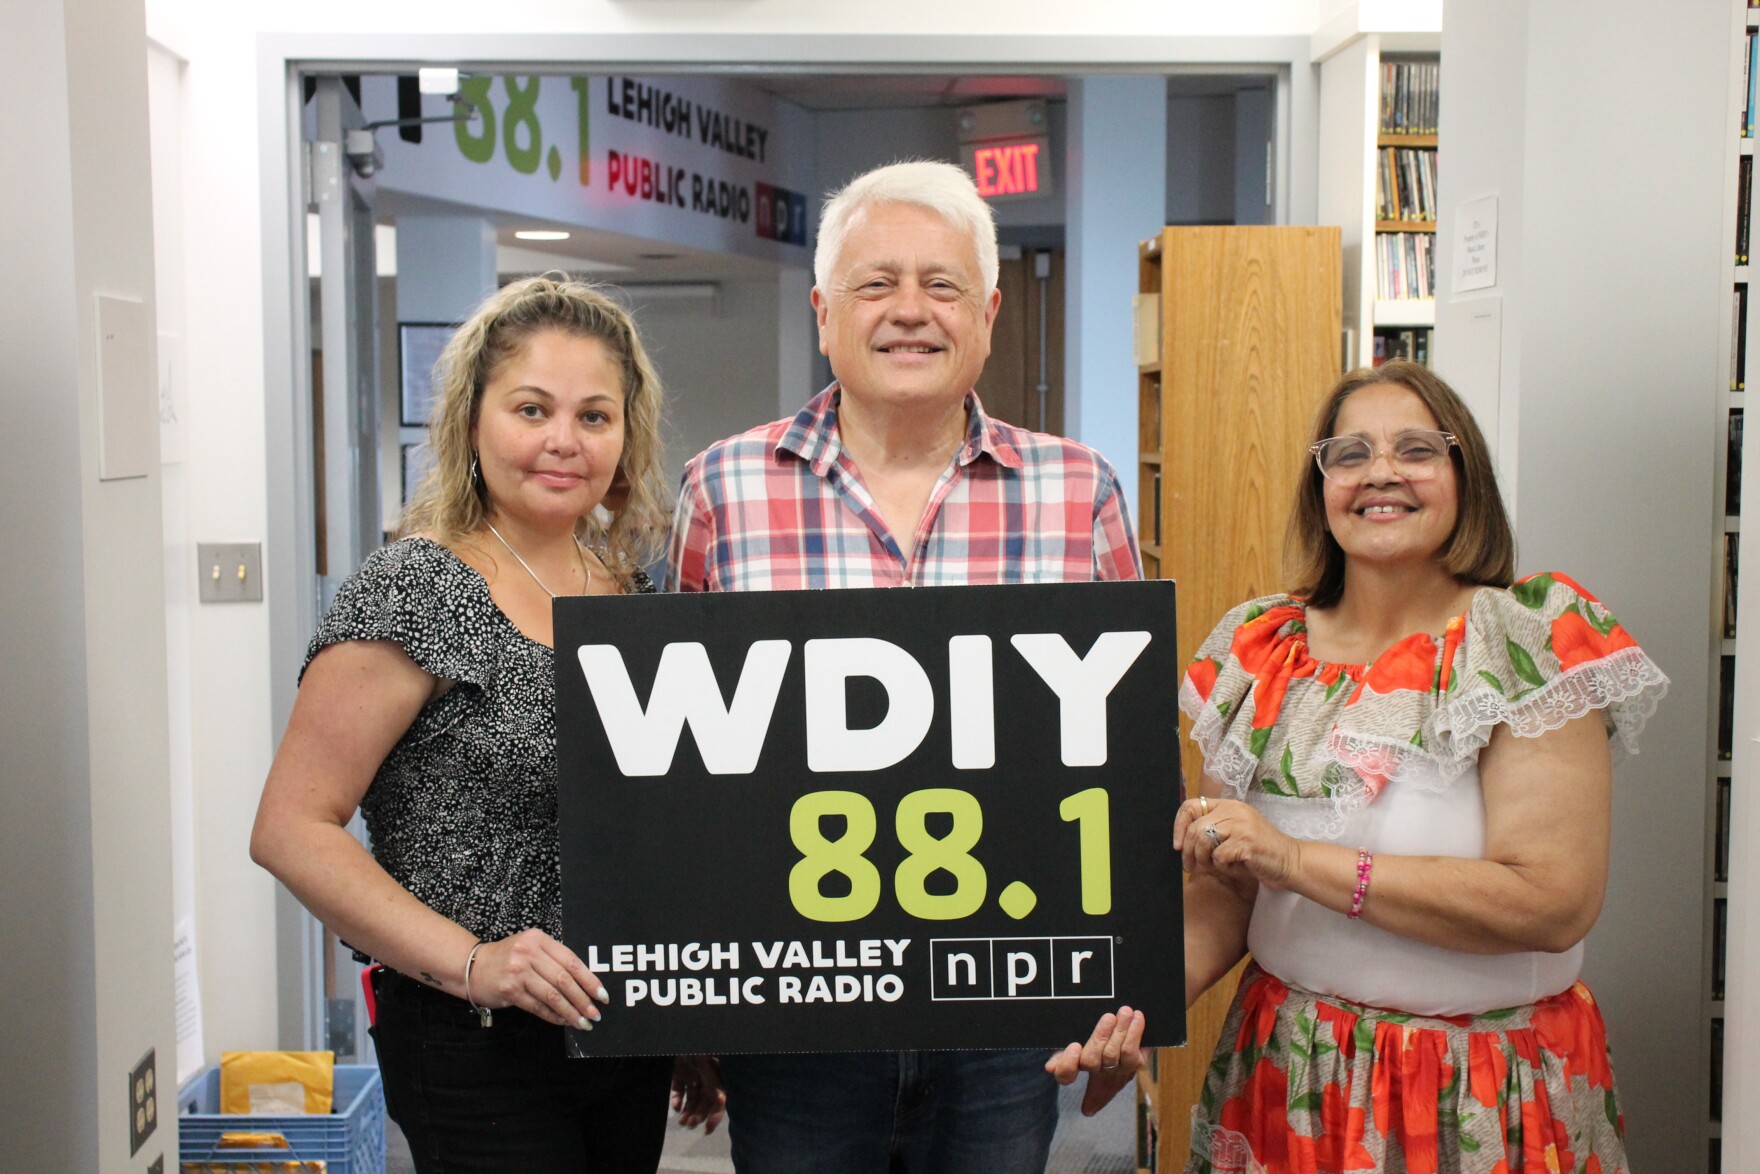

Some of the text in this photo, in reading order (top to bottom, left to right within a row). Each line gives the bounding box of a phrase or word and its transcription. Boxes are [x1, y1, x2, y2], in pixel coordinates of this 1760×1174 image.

[607, 76, 768, 163] LEHIGH VALLEY
[608, 149, 750, 225] PUBLIC RADIO
[975, 144, 1039, 197] EXIT
[759, 195, 804, 237] npr
[577, 631, 1152, 777] WDIY
[788, 787, 1112, 923] 88.1
[588, 939, 911, 973] LEHIGH VALLEY
[947, 950, 1094, 997] npr
[625, 974, 905, 1007] PUBLIC RADIO
